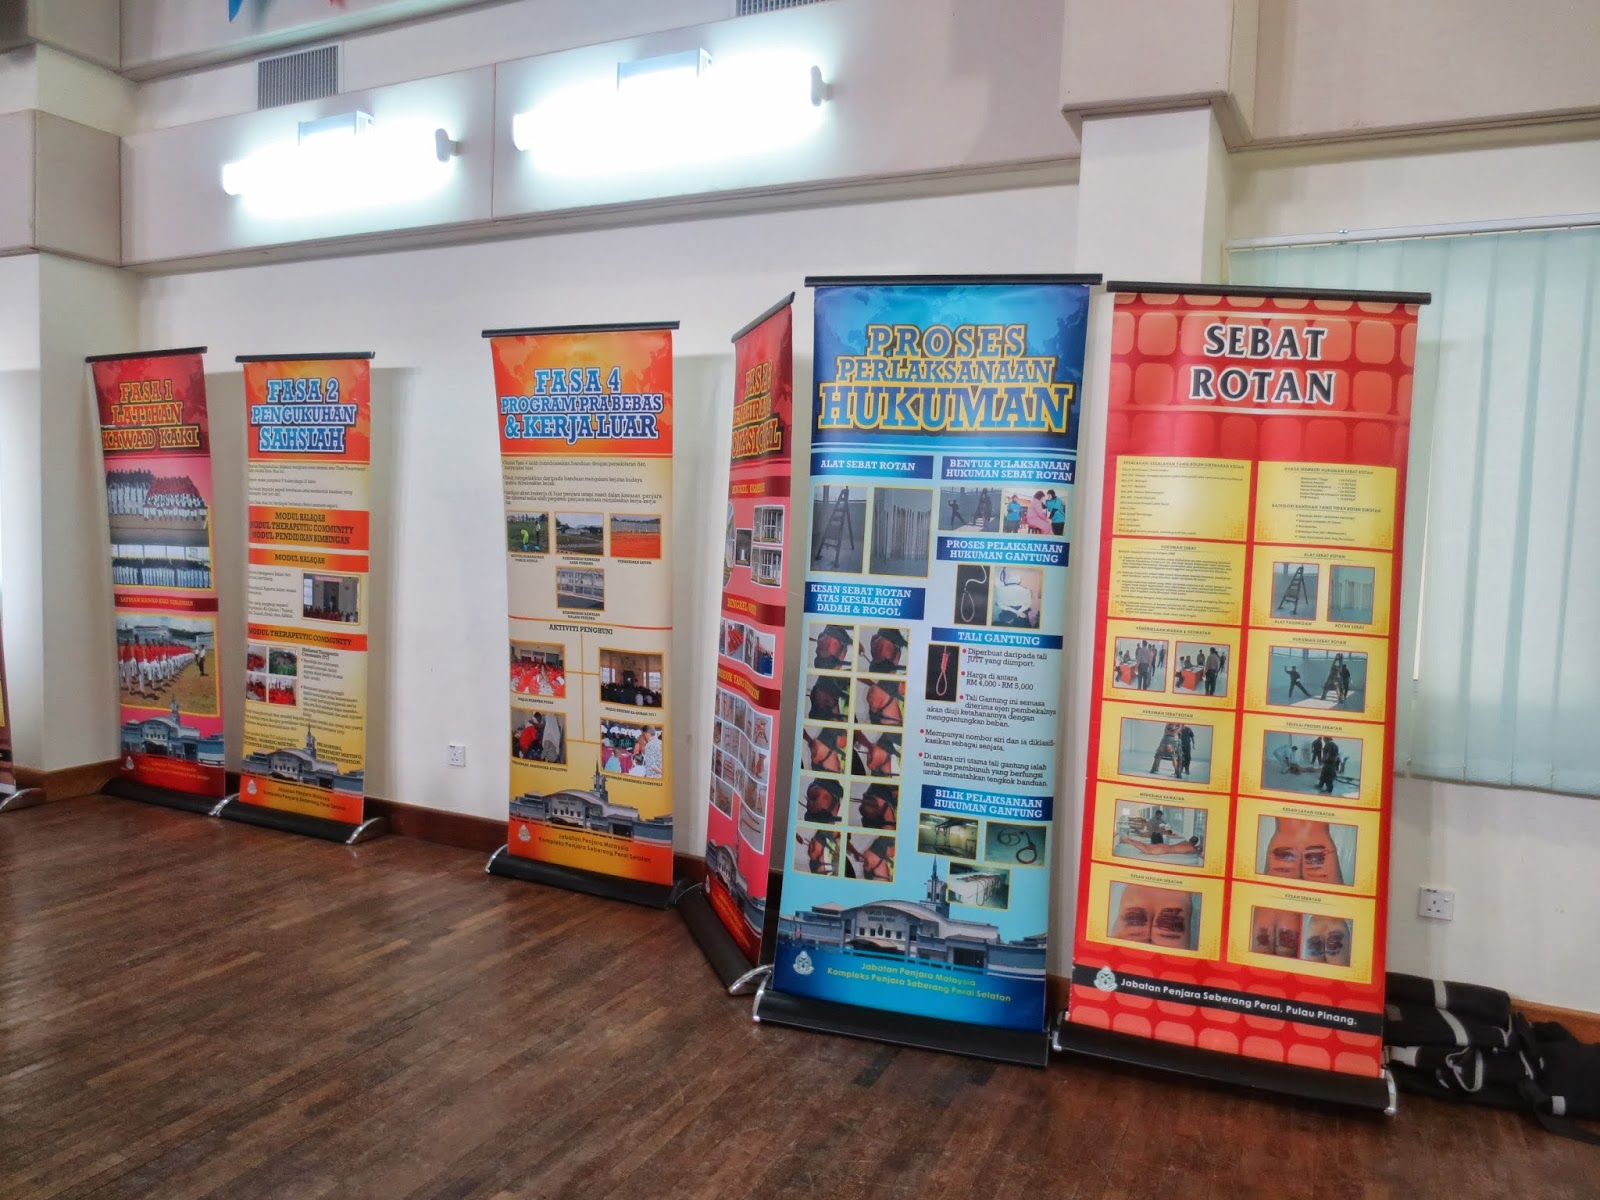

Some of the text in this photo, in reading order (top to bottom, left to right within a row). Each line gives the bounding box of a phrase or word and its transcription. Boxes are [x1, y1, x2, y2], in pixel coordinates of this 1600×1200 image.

[866, 324, 1027, 358] PROSES
[1204, 323, 1328, 360] SEBAT
[836, 356, 1056, 384] PERLAKSANAAN
[534, 366, 621, 395] FASA 4
[1189, 366, 1337, 405] ROTAN
[119, 379, 173, 403] FASA 1
[267, 377, 339, 403] FASA 2
[501, 396, 579, 414] PROGRAM
[818, 382, 1074, 433] HUKUMAN
[111, 401, 183, 426] LATIHAN
[251, 404, 357, 425] PENGUKUHAN
[505, 413, 659, 445] & KERJA LUAR
[102, 425, 199, 450] KAWAD KAKI
[259, 426, 345, 452] SAHSIAH
[821, 460, 916, 471] ALAT SEBAT ROTAN
[950, 459, 1070, 471] BENTUK PELAKSANAAN
[946, 469, 1072, 481] HUKUMAN SEBAT ROTAN
[275, 512, 299, 521] MODUL
[314, 525, 354, 534] COMMUNITY
[946, 540, 1063, 553] PROSES PELAKSANAAN
[275, 554, 299, 562] MODUL
[950, 550, 1059, 563] HUKUMAN GANTUNG
[811, 584, 911, 598] KESAN SEBAT ROTAN
[816, 594, 902, 607] ATAS KESALAHAN
[817, 603, 850, 613] DADAH
[862, 606, 900, 616] ROGOL
[549, 624, 613, 635] AKTIVITI PENGHUNI
[958, 631, 1040, 646] TALI GANTUNG
[968, 647, 1003, 658] Diperbuat
[1003, 651, 1035, 661] daripada
[984, 658, 1001, 666] yang
[966, 671, 1018, 682] Harga di antara
[966, 678, 979, 686] RM
[979, 679, 997, 688] 4,000
[965, 694, 978, 702] Tali
[979, 695, 1008, 705] Gantung
[1009, 697, 1018, 705] ini
[927, 706, 943, 714] akan
[944, 707, 960, 715] diuji
[1008, 712, 1035, 722] dengan
[965, 702, 993, 711] diterima
[994, 705, 1010, 713] ejen
[926, 714, 985, 726] menggantungkan
[925, 729, 964, 739] Mempunyai
[966, 734, 992, 742] nombor
[925, 737, 950, 745] kasikan
[952, 740, 978, 749] sebagai
[923, 760, 952, 770] tembaga
[953, 764, 990, 774] pembunuh
[991, 768, 1009, 776] yang
[924, 752, 931, 760] Di
[967, 758, 987, 766] utama
[1000, 760, 1029, 771] gantung
[943, 771, 986, 782] mematahkan
[987, 776, 1015, 785] tengkok
[935, 788, 1043, 808] BILIK PELAKSANAAN
[934, 799, 1043, 818] HUKUMAN GANTUNG
[862, 962, 976, 988] Jabatan Penjara Malaysia
[827, 967, 1012, 1002] Kompleks Penjara Seberang Perai Selatan
[1120, 977, 1358, 1026] Jabatan Penjara Seberang Perai, Pulau Pinang.
